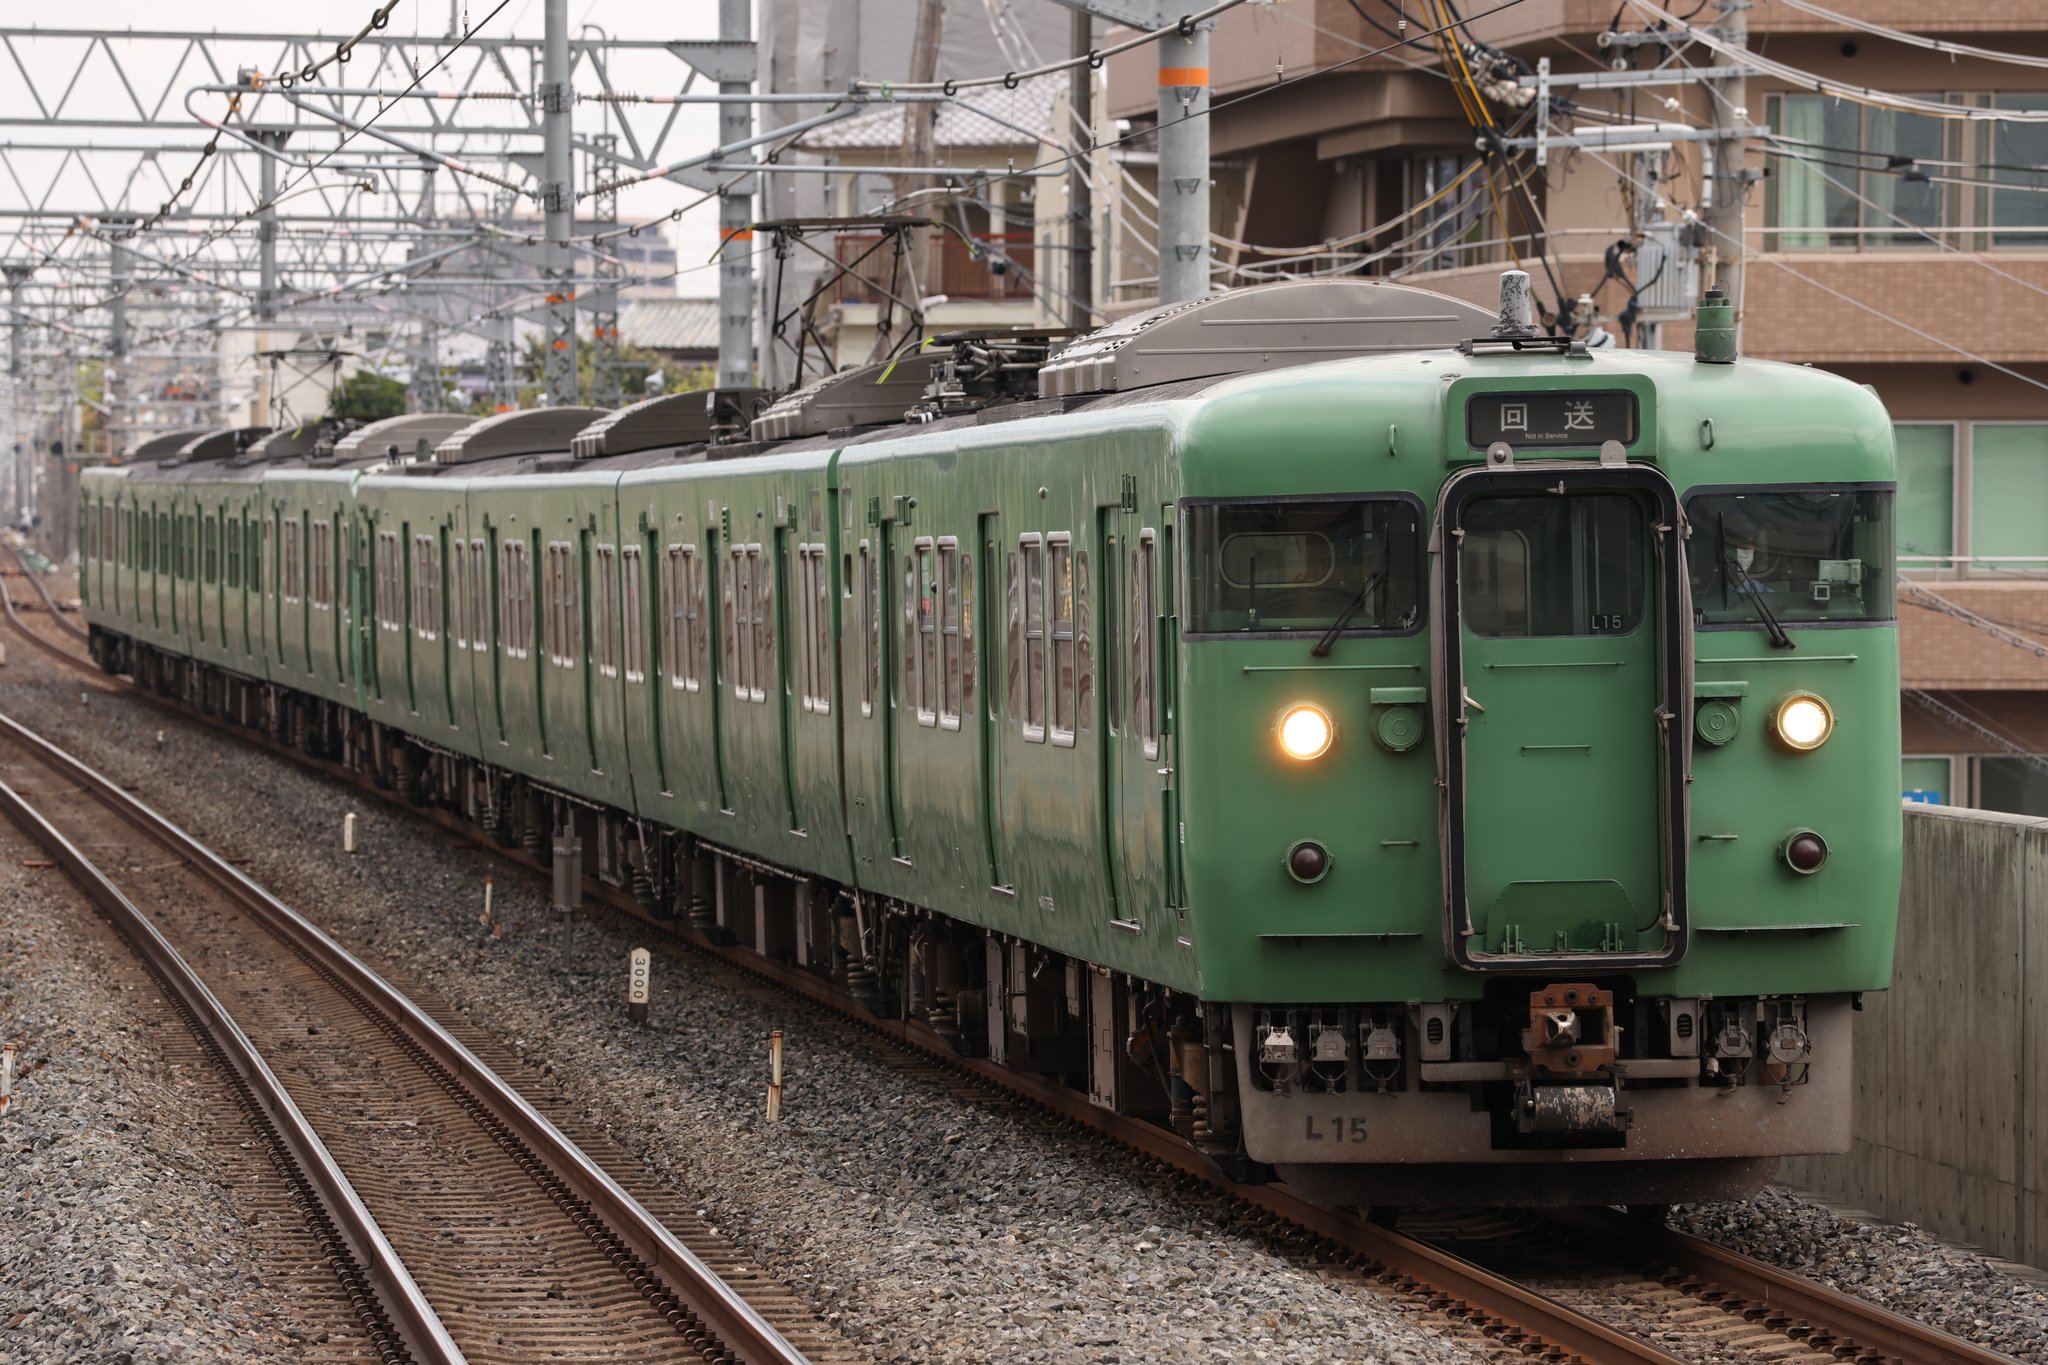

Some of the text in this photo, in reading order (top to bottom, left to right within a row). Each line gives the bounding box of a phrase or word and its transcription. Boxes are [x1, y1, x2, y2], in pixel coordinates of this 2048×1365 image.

[1501, 401, 1595, 431] 回送
[1545, 432, 1568, 440] Service
[1592, 615, 1622, 629] L15
[633, 957, 646, 999] 3000
